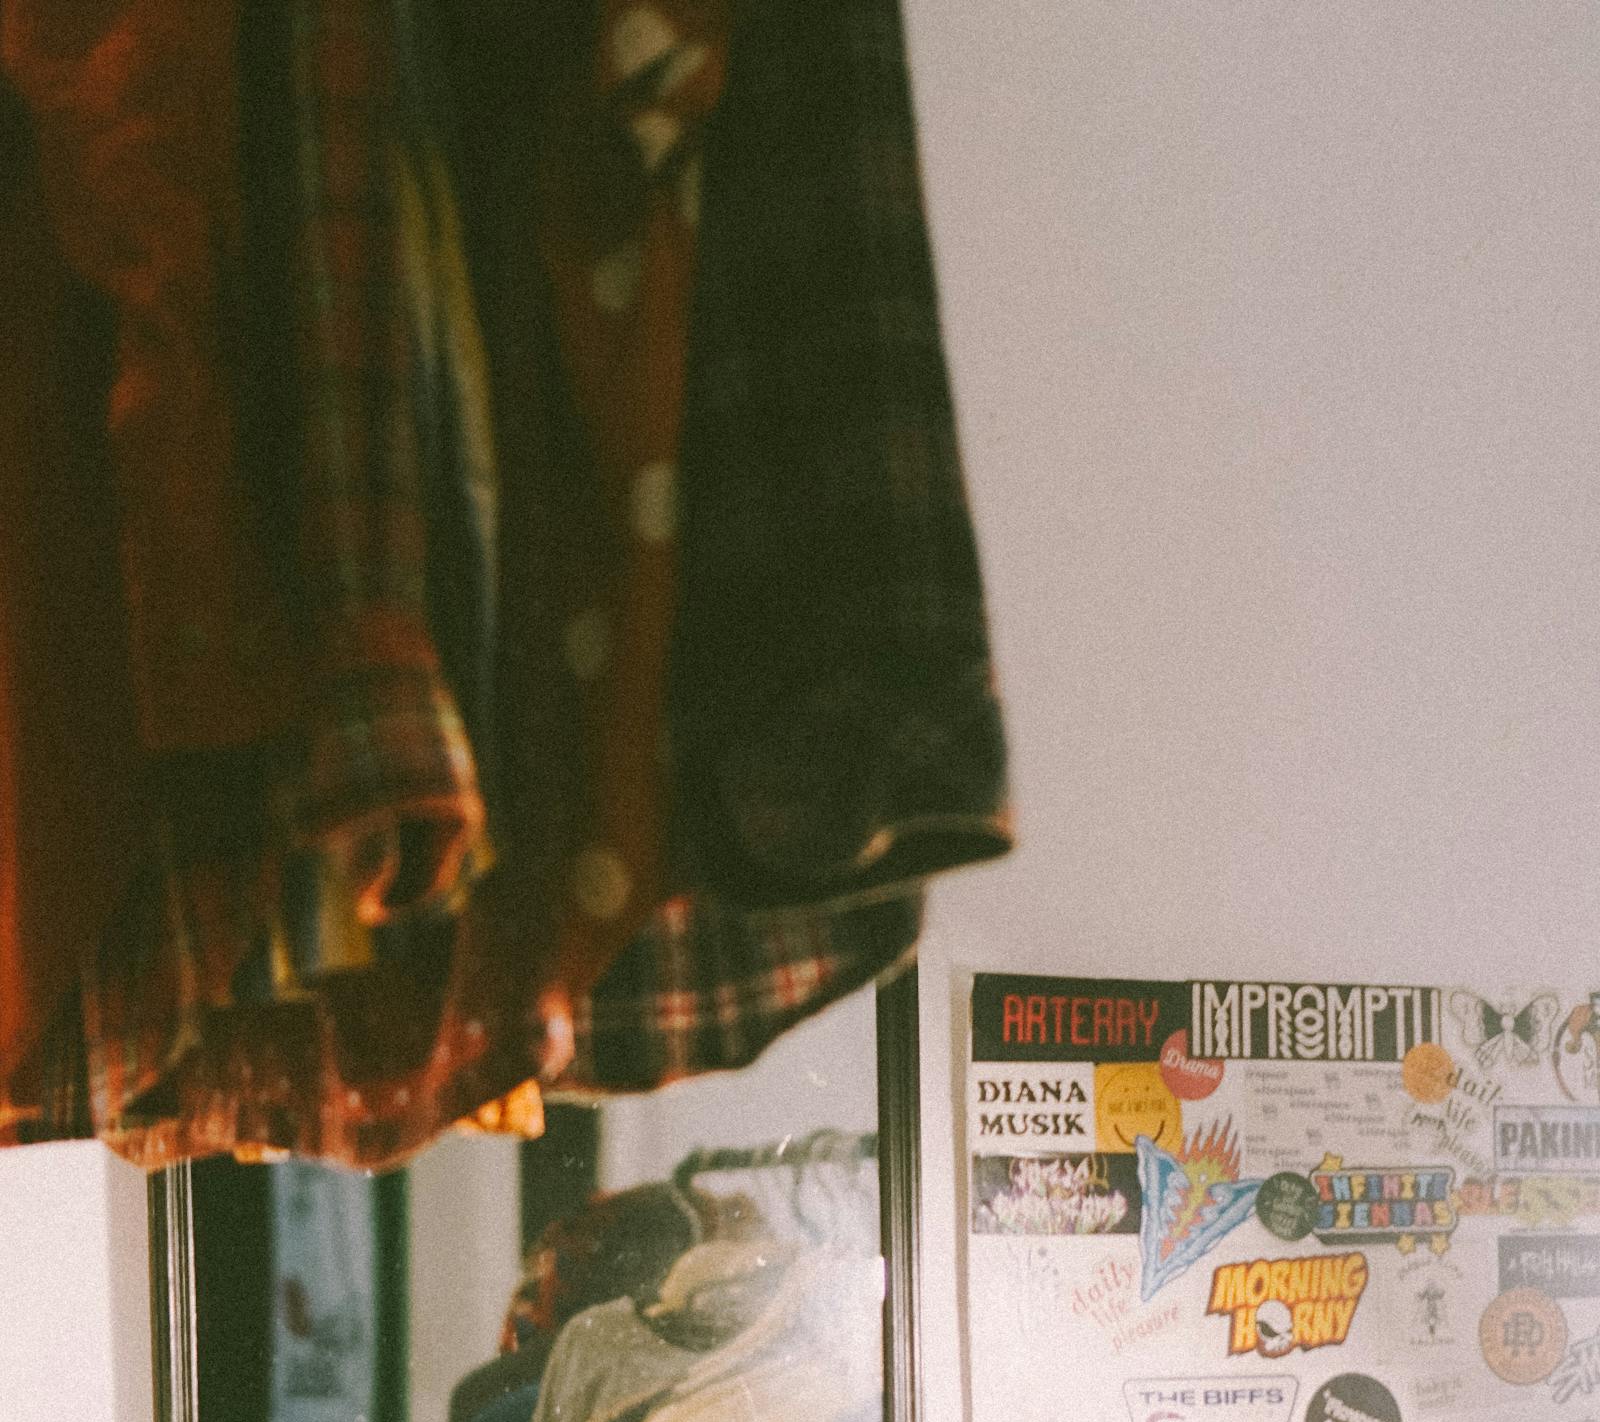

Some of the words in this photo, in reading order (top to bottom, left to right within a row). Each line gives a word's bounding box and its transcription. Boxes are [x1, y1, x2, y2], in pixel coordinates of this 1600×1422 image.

[977, 1079, 1088, 1104] DIANA
[978, 1113, 1088, 1137] MUSIK
[1206, 1252, 1369, 1316] MORNING
[1138, 1389, 1196, 1406] THE
[1203, 1387, 1284, 1407] BIFFS
